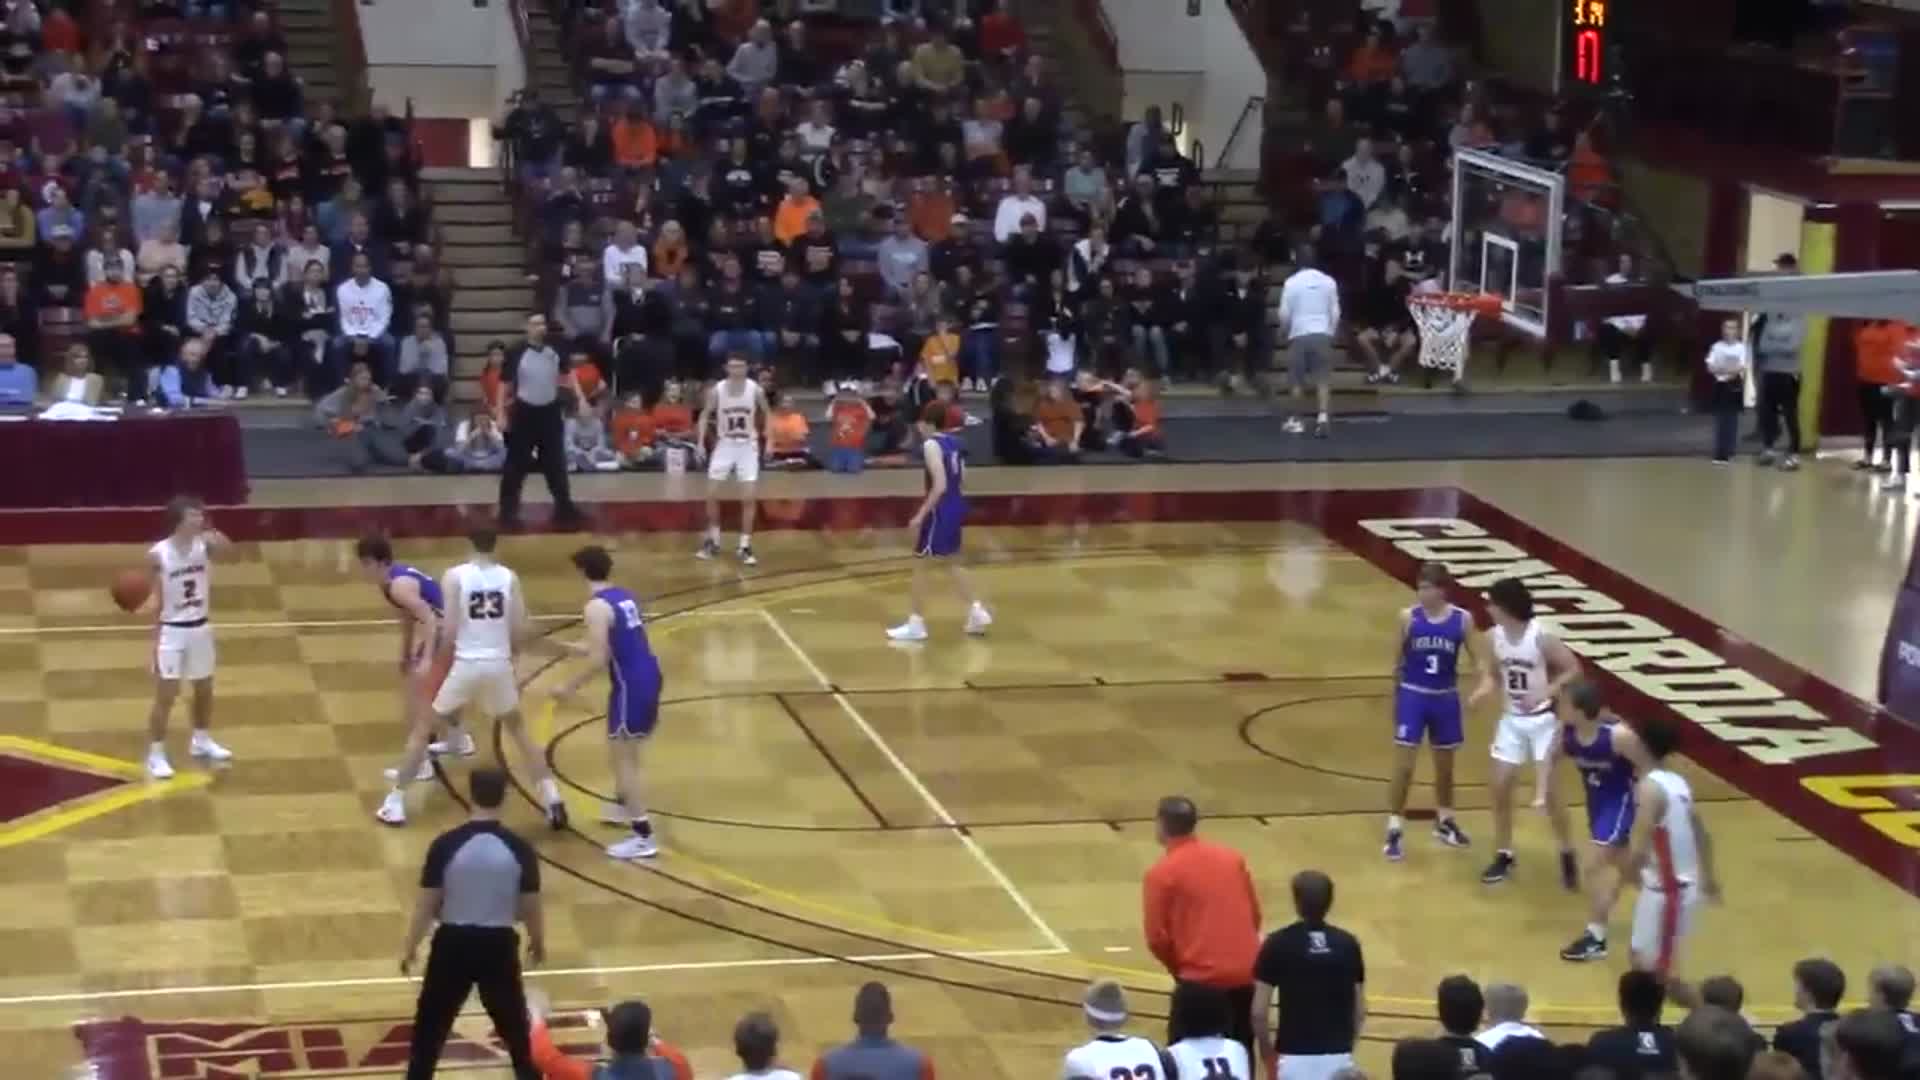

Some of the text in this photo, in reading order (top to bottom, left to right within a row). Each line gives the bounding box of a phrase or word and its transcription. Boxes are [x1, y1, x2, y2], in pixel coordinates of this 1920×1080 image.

[728, 416, 745, 431] 14
[183, 580, 196, 598] 2
[469, 591, 505, 619] 23
[1357, 518, 1881, 764] CONCORDIA
[1424, 655, 1439, 674] 3
[1508, 671, 1528, 690] 21
